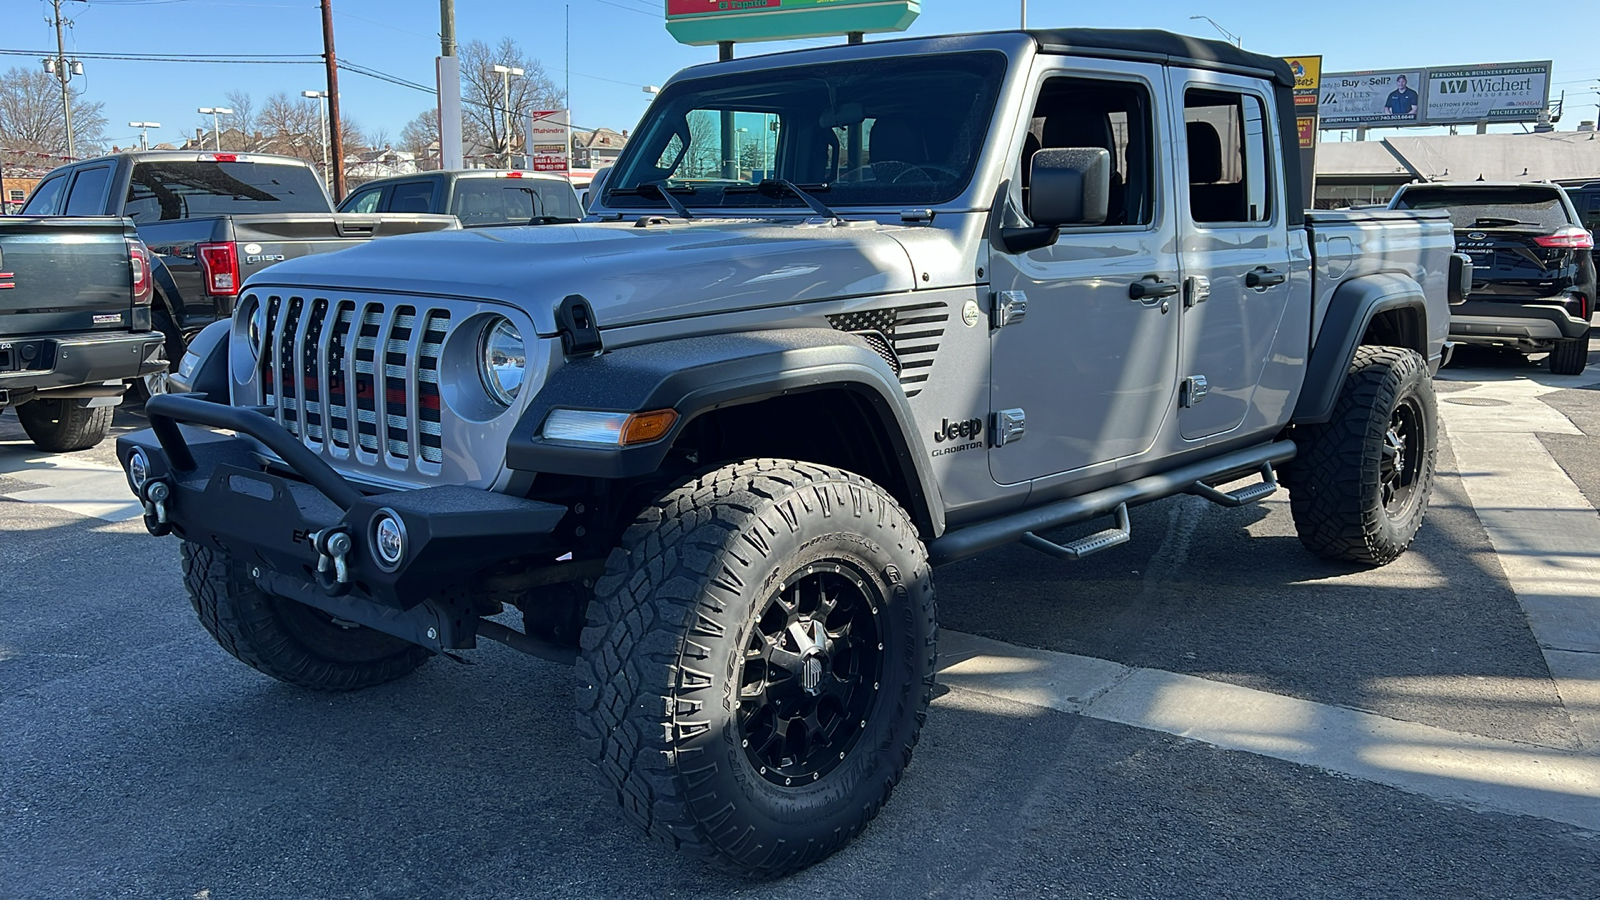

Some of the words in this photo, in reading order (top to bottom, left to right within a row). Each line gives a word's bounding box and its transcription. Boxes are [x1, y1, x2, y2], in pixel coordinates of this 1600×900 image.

[1341, 79, 1360, 88] Buy
[1369, 77, 1391, 86] Sell?
[1470, 77, 1532, 93] Wichert
[934, 417, 983, 443] Jeep
[931, 441, 983, 457] GLADIATOR
